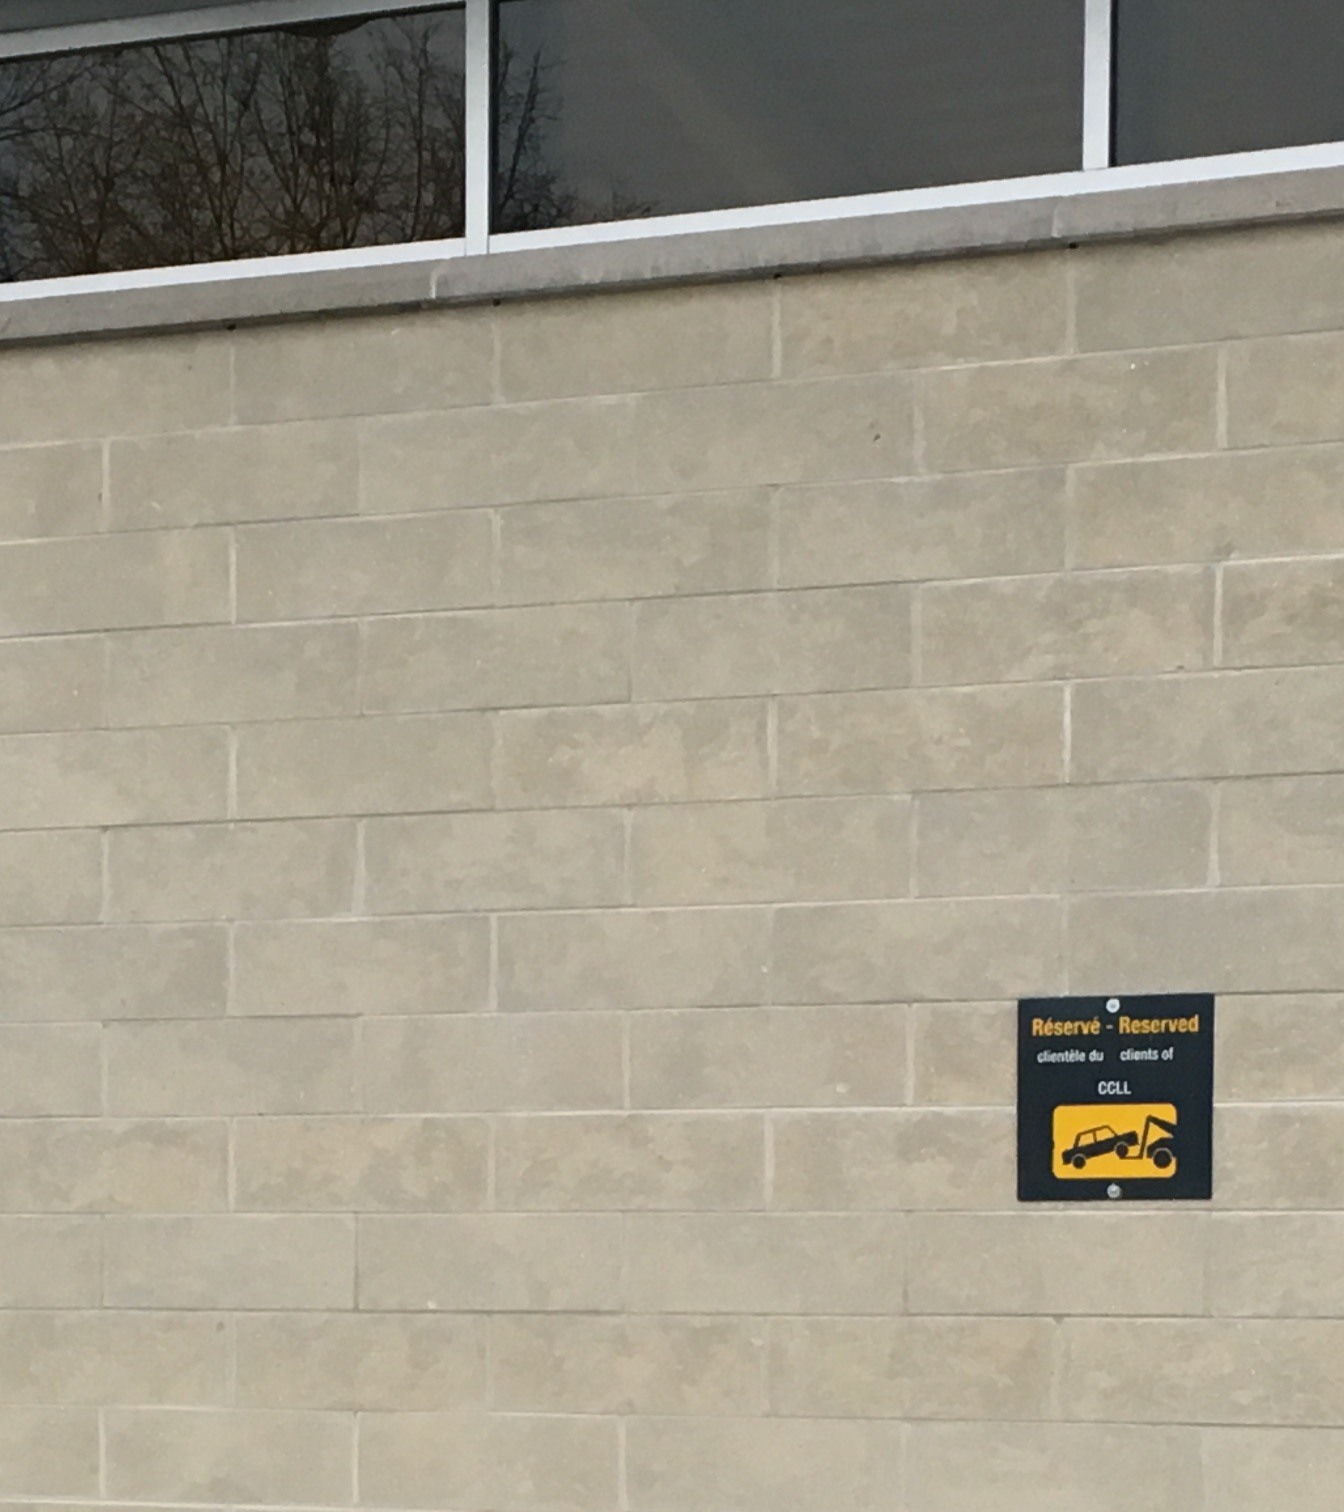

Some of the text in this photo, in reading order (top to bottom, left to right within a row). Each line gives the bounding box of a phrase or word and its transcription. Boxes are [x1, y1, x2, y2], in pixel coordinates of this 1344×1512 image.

[1032, 1016, 1101, 1036] Réservé
[1118, 1014, 1200, 1035] Reserved
[1088, 1049, 1105, 1062] du
[1119, 1047, 1175, 1061] clients of
[1097, 1080, 1132, 1095] CCLL
